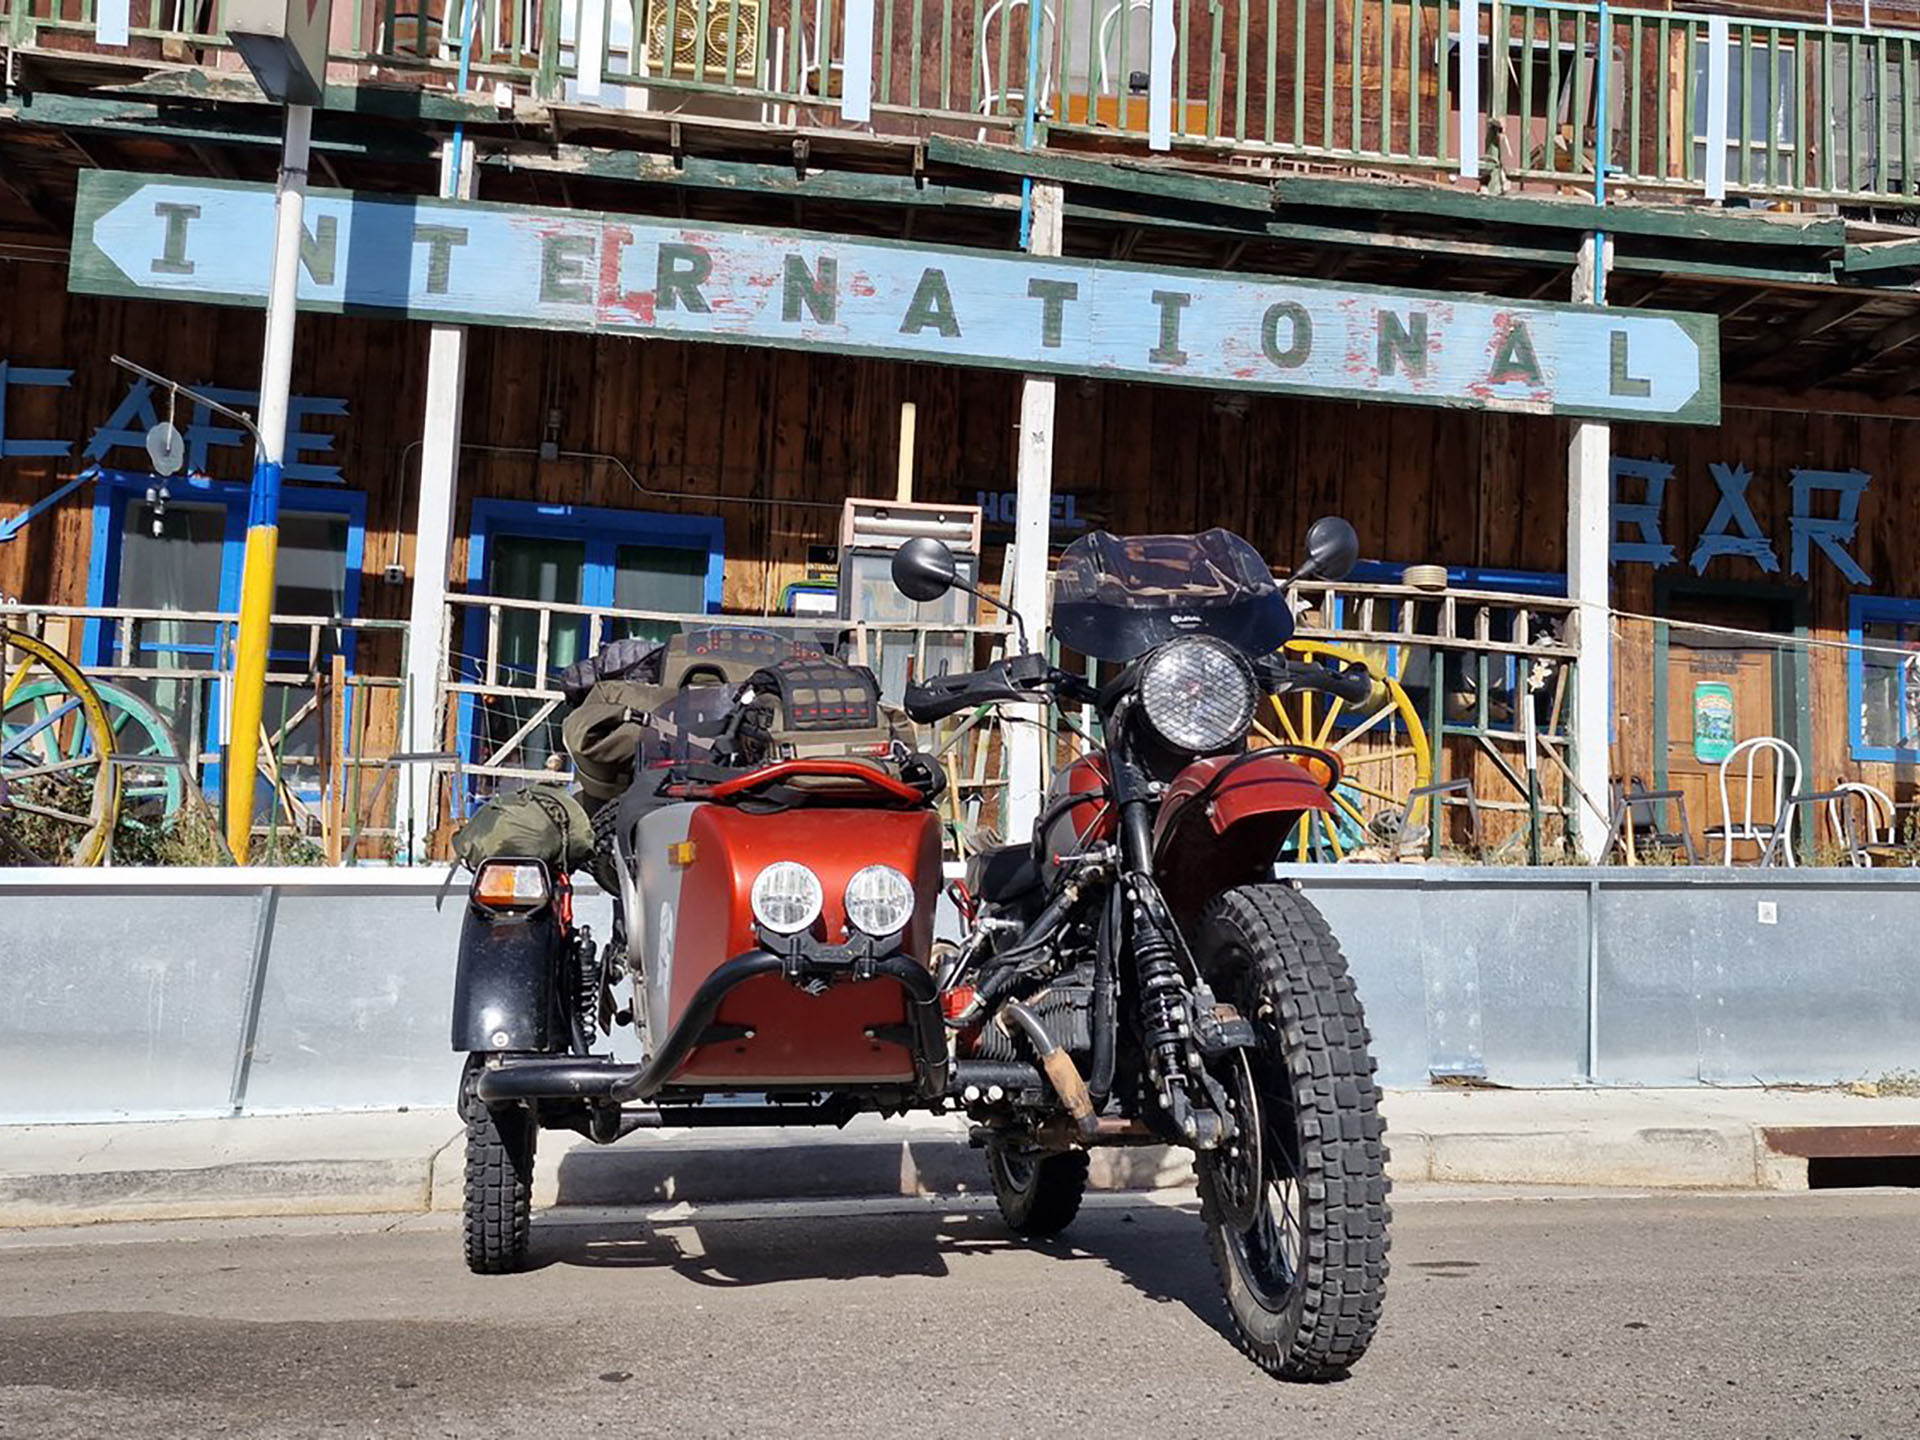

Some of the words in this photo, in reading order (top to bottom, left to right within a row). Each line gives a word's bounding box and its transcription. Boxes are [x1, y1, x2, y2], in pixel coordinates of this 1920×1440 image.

[151, 202, 1651, 397] INTERNATIONAL
[977, 491, 1087, 528] HOEL
[1608, 455, 1872, 586] BAR
